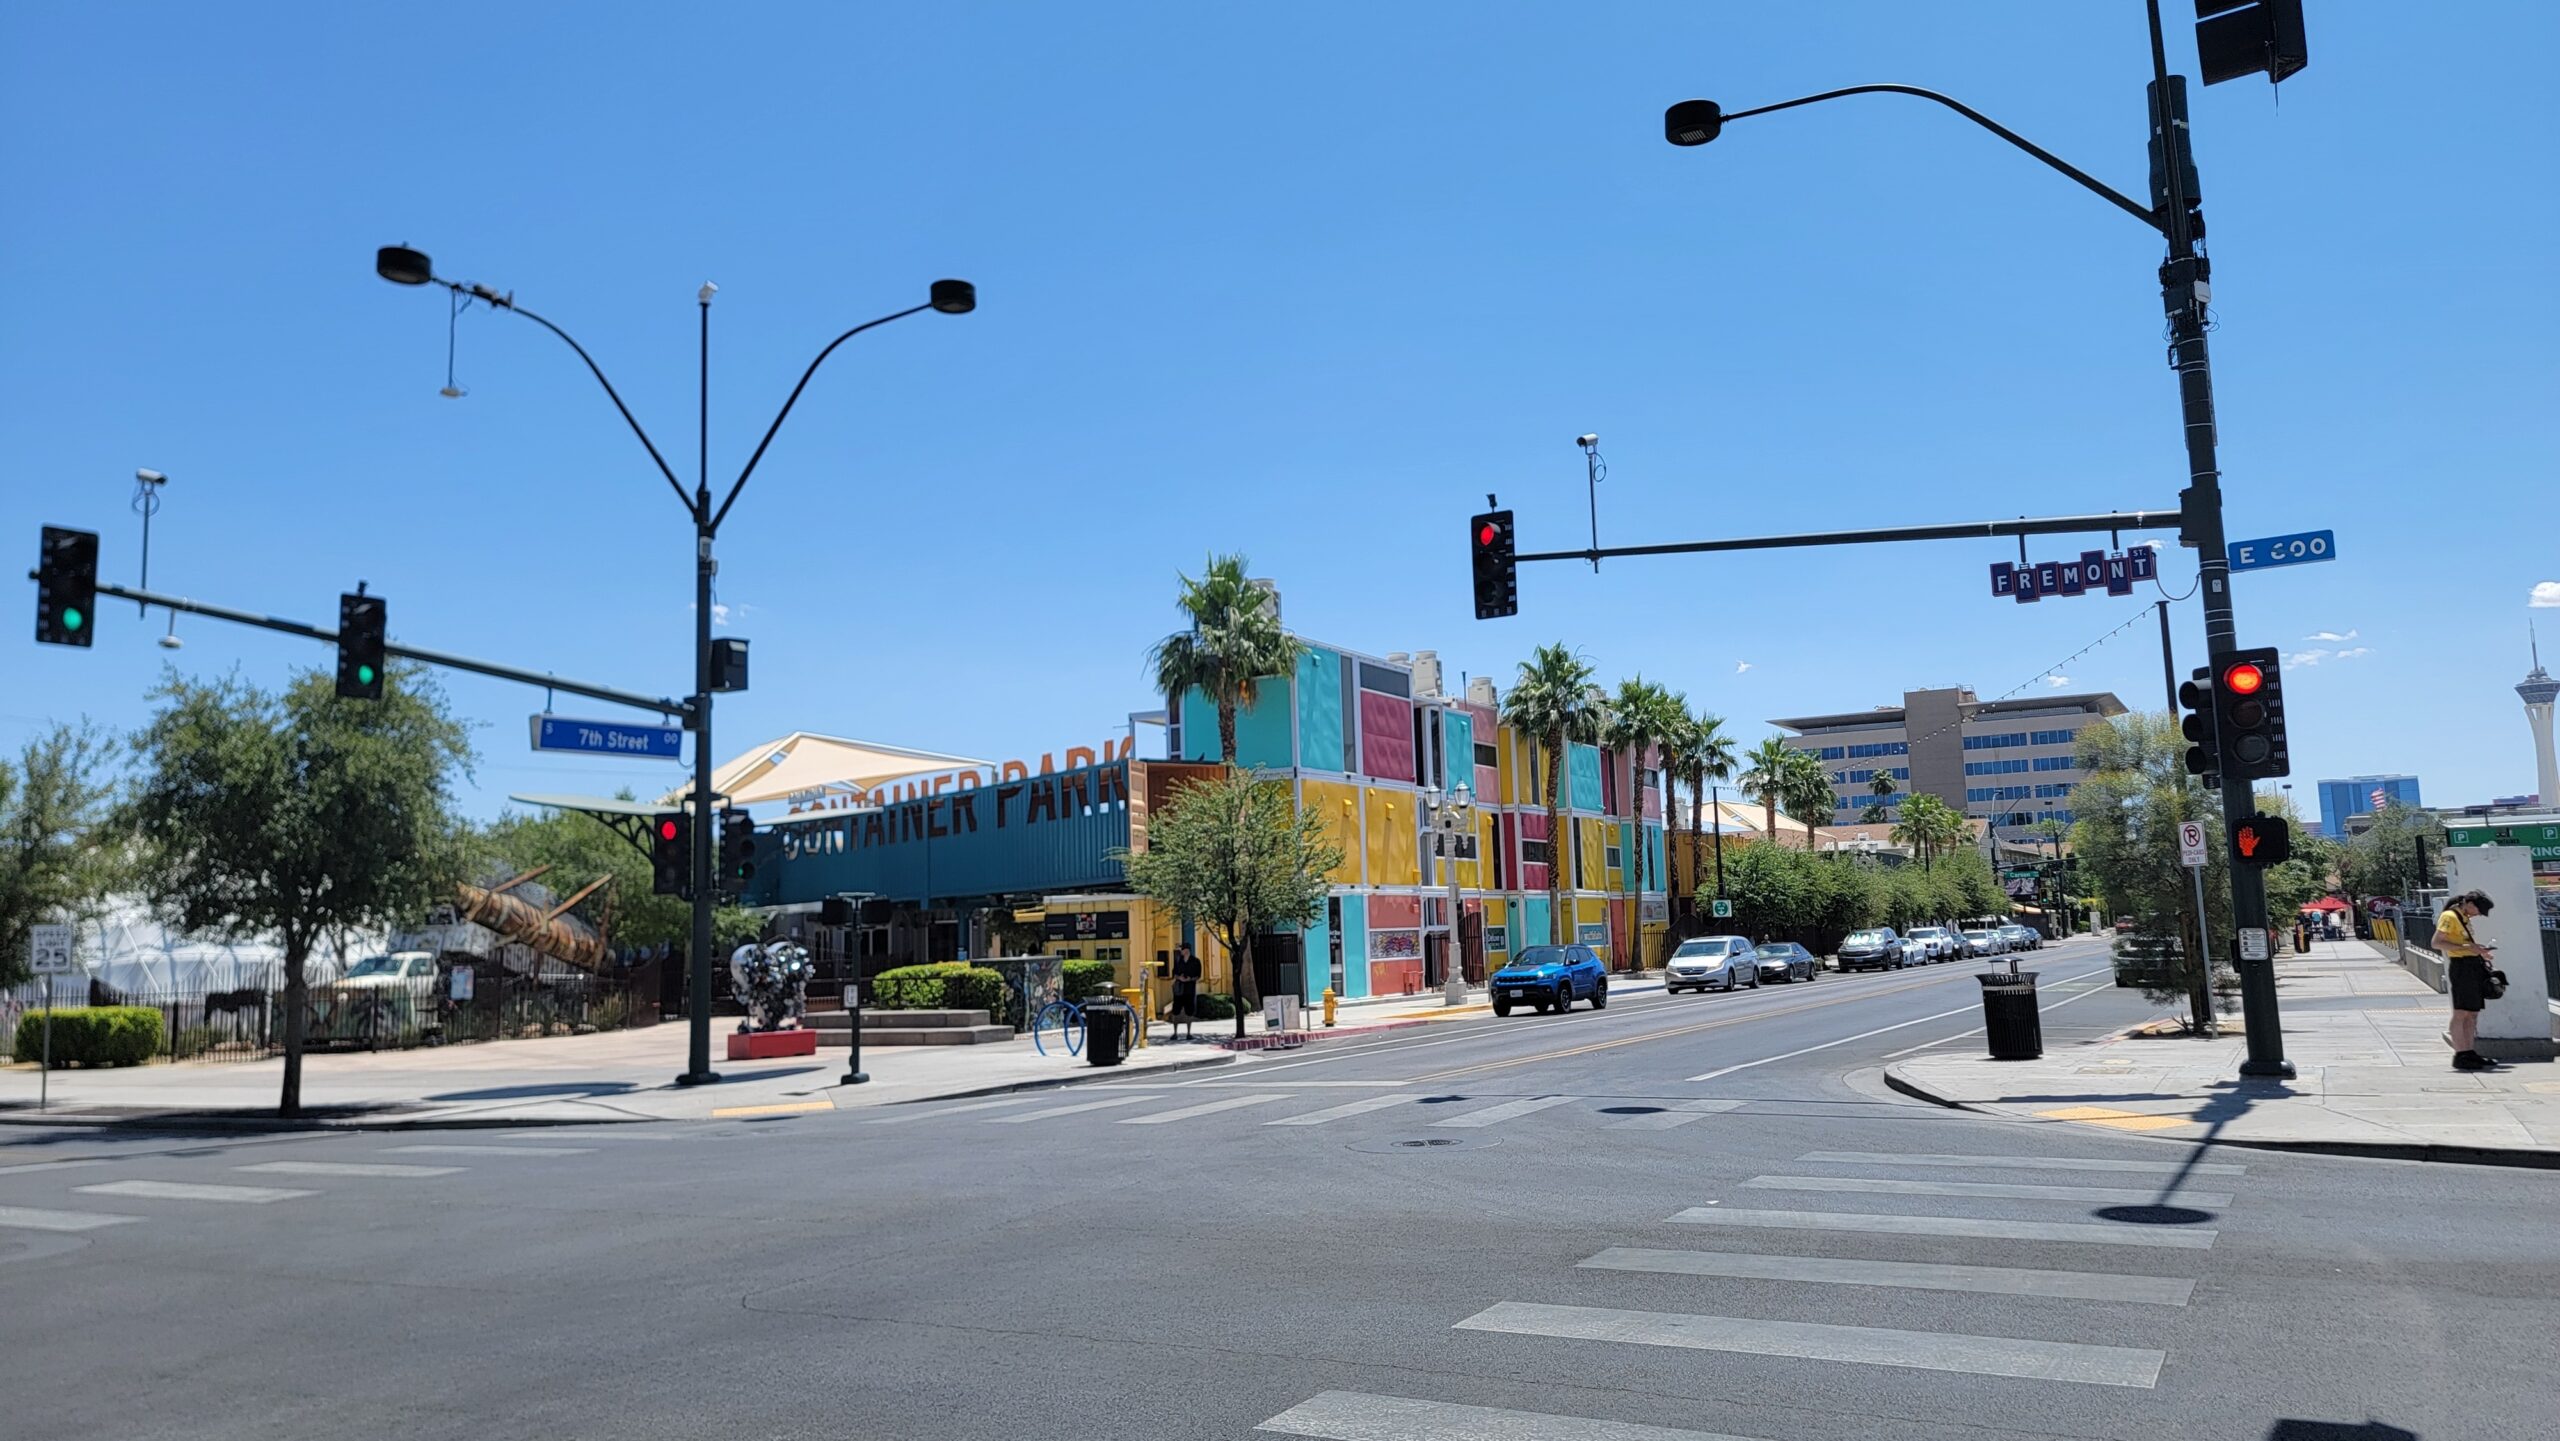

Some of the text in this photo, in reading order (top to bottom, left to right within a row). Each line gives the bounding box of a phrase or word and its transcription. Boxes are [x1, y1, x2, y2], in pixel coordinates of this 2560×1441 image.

[2239, 546, 2255, 564] E
[1996, 558, 2147, 592] FREMONT
[546, 722, 554, 734] S
[578, 728, 603, 747] 7th
[607, 731, 649, 750] Street
[996, 734, 1134, 829] PARK
[36, 948, 68, 967] 25
